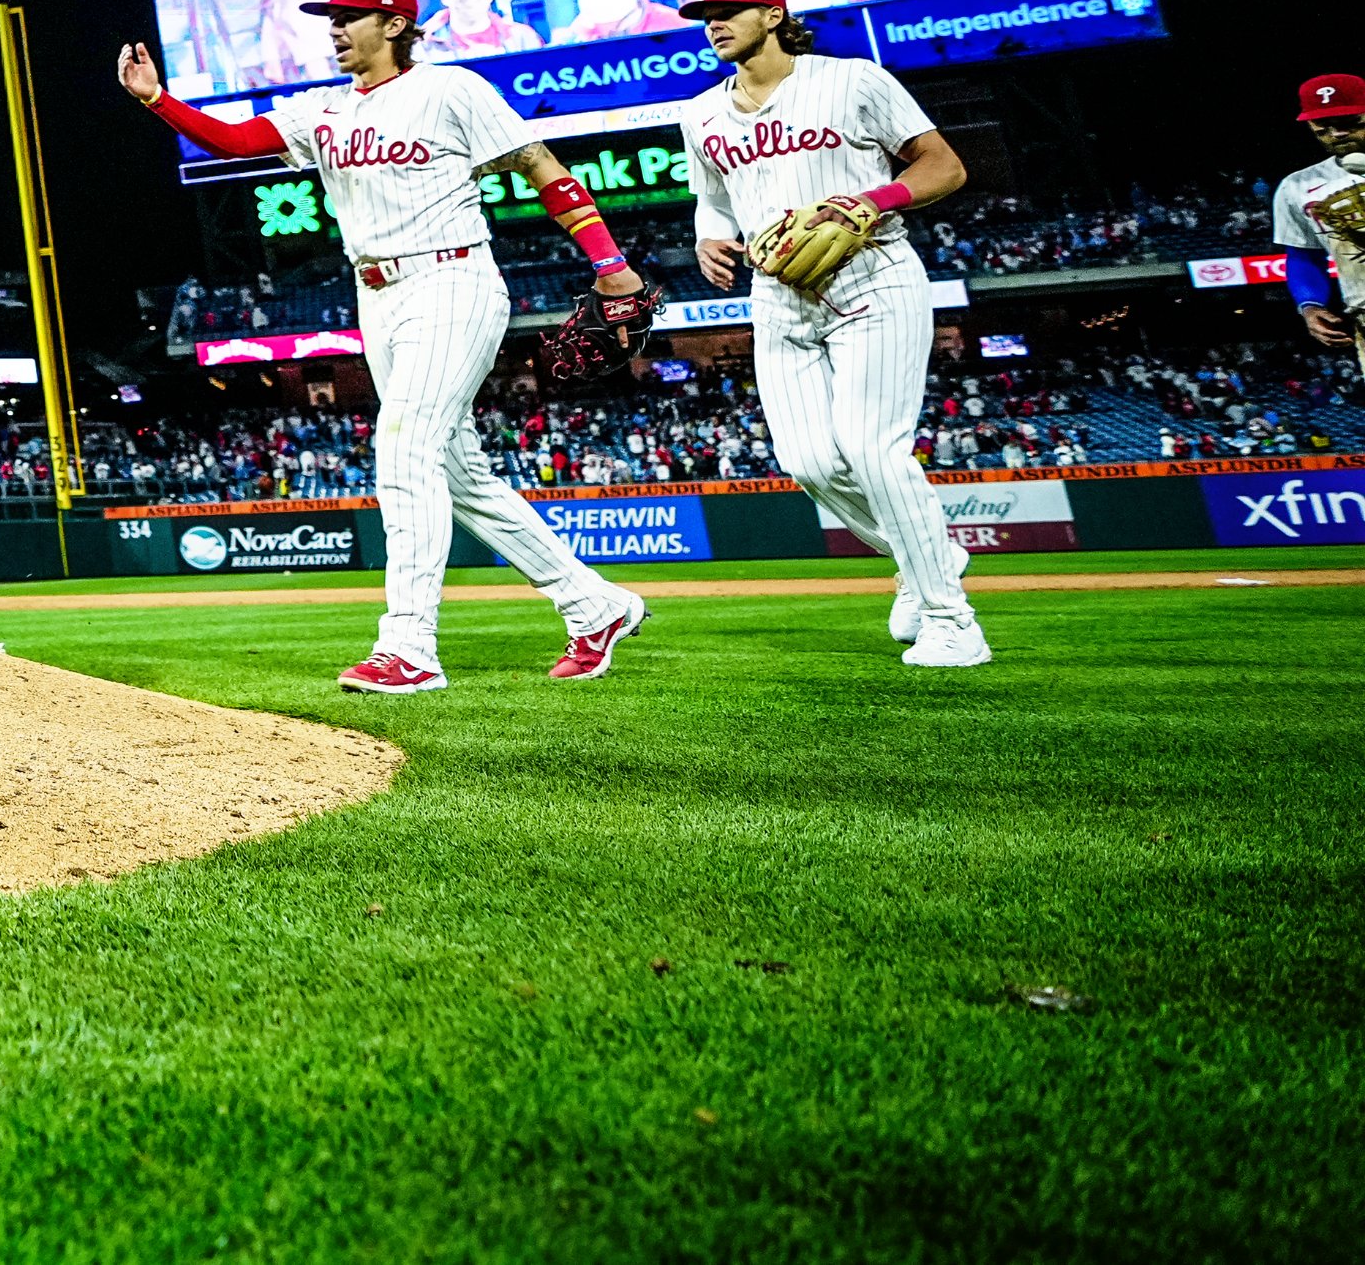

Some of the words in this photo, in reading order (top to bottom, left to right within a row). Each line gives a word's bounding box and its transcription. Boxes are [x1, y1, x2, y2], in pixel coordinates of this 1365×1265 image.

[512, 48, 719, 96] CASAMIGOS
[1316, 86, 1336, 104] P
[314, 124, 431, 171] Phillies
[703, 120, 842, 176] Phillies
[569, 192, 579, 202] 5
[684, 302, 752, 323] LISCI
[1010, 465, 1138, 481] ASPLUNDH
[1166, 458, 1303, 475] ASPLUNDH
[598, 483, 703, 498] ASPLUNDH
[146, 504, 231, 518] ASPLUNDH
[252, 500, 341, 514] ASPLUNDH
[1236, 479, 1365, 537] xfin
[547, 506, 676, 531] SHERWIN
[119, 520, 152, 539] 334
[229, 525, 353, 552] NovaCare
[231, 553, 351, 568] REHABILITATION
